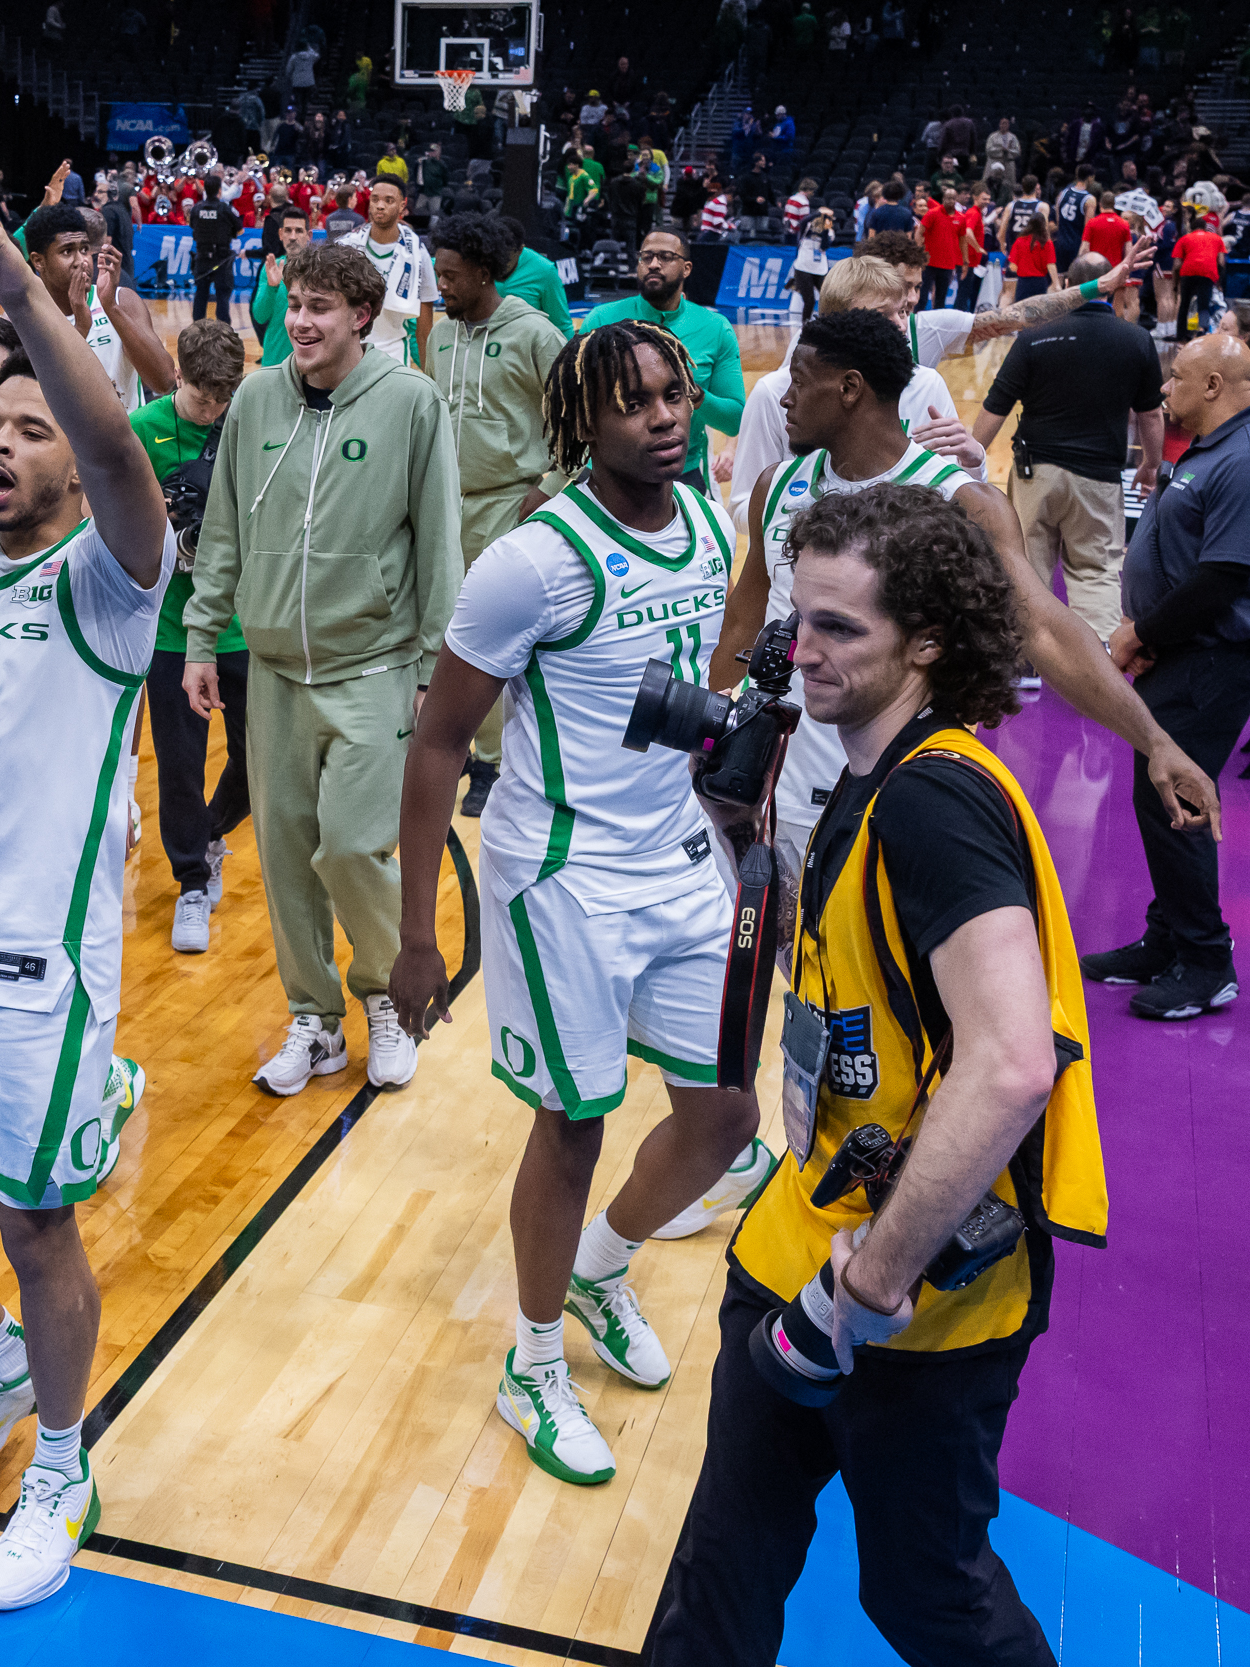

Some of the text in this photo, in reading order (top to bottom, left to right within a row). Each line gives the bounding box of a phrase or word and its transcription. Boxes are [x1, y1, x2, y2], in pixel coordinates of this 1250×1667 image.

[199, 209, 218, 220] POLICE
[1060, 203, 1078, 221] 45
[341, 438, 369, 462] O
[611, 562, 628, 571] NCAA
[617, 588, 725, 630] DUCKS
[665, 622, 701, 687] 11
[737, 907, 756, 949] EOS
[25, 962, 36, 971] 46
[500, 1026, 536, 1078] O
